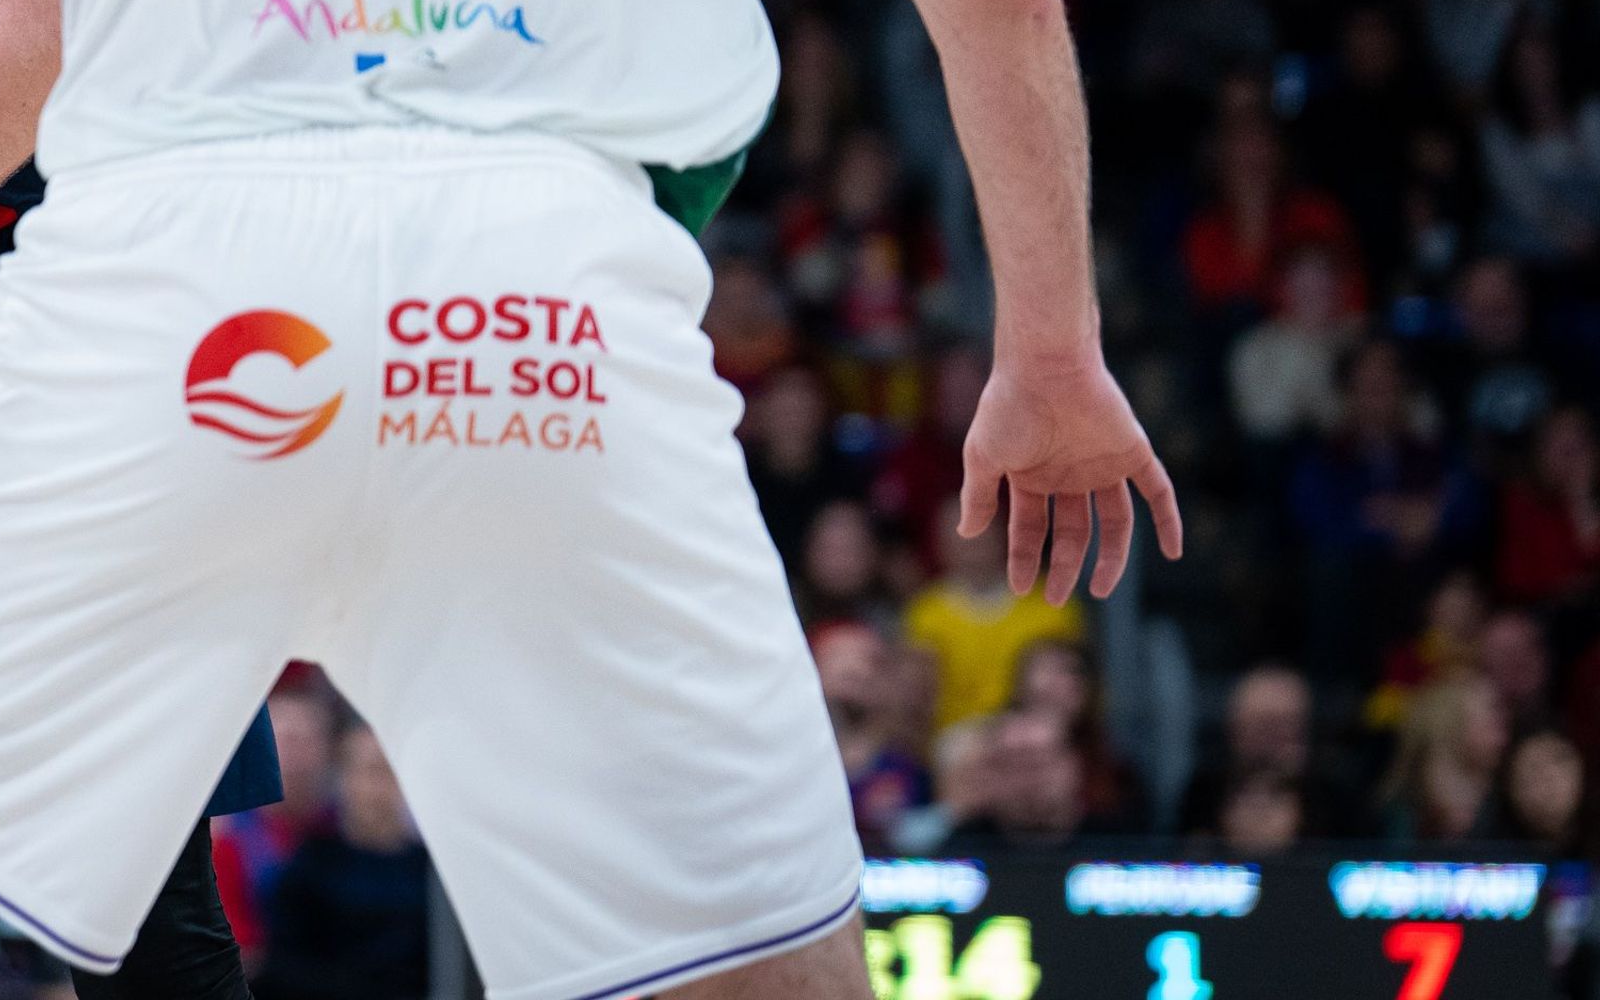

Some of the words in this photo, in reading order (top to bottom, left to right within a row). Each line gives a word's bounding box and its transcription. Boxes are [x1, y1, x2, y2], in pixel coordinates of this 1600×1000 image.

[387, 294, 606, 350] COSTA
[383, 358, 492, 399] DEL
[510, 358, 606, 404] SOL
[377, 402, 606, 452] MÁLAGA
